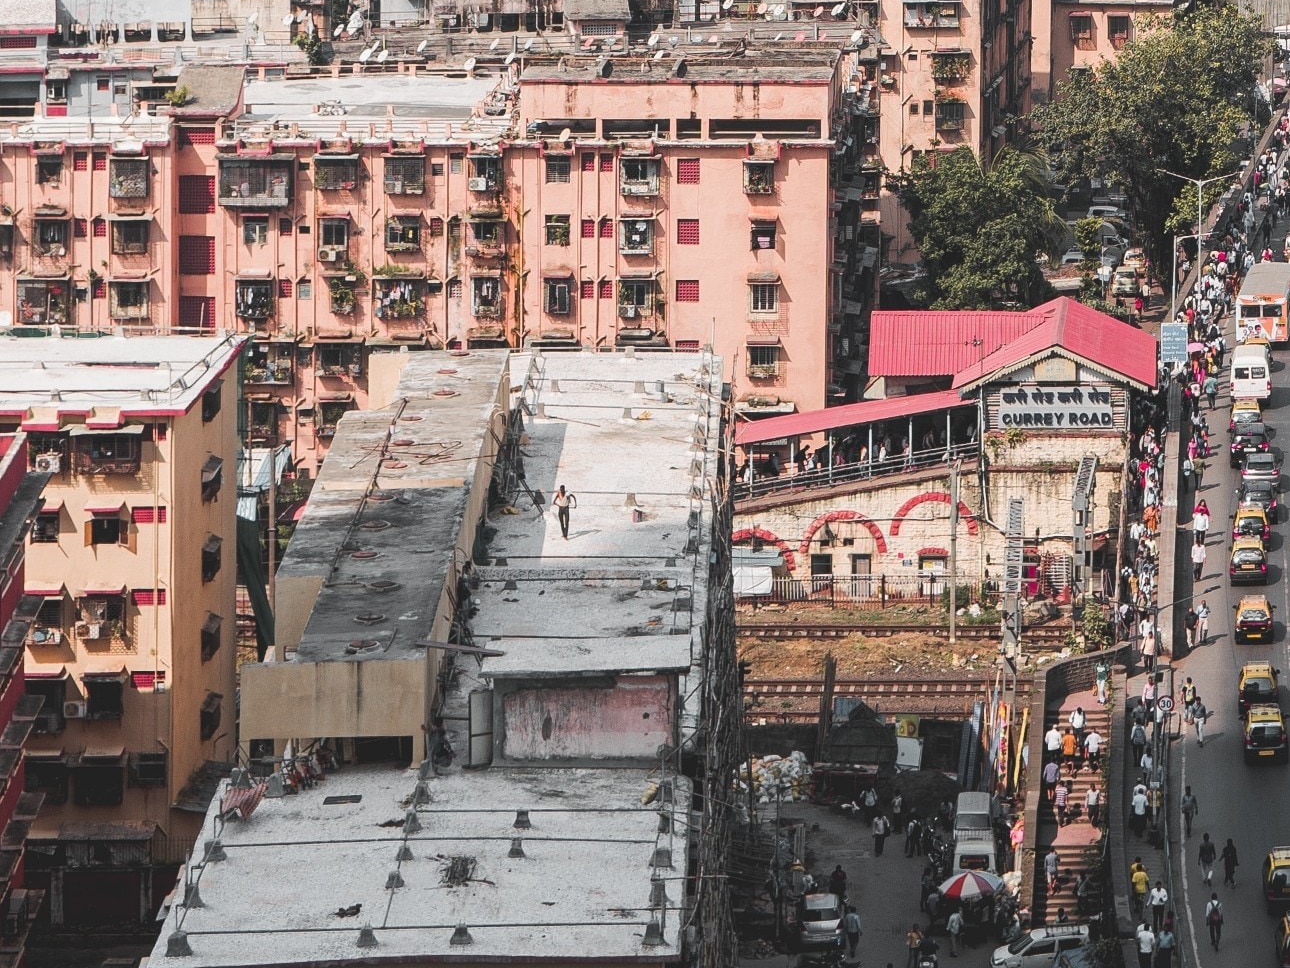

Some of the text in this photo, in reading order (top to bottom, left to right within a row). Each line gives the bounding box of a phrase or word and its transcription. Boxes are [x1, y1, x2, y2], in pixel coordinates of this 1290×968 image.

[1002, 412, 1112, 426] CURREY ROAD
[1161, 699, 1171, 709] 30
